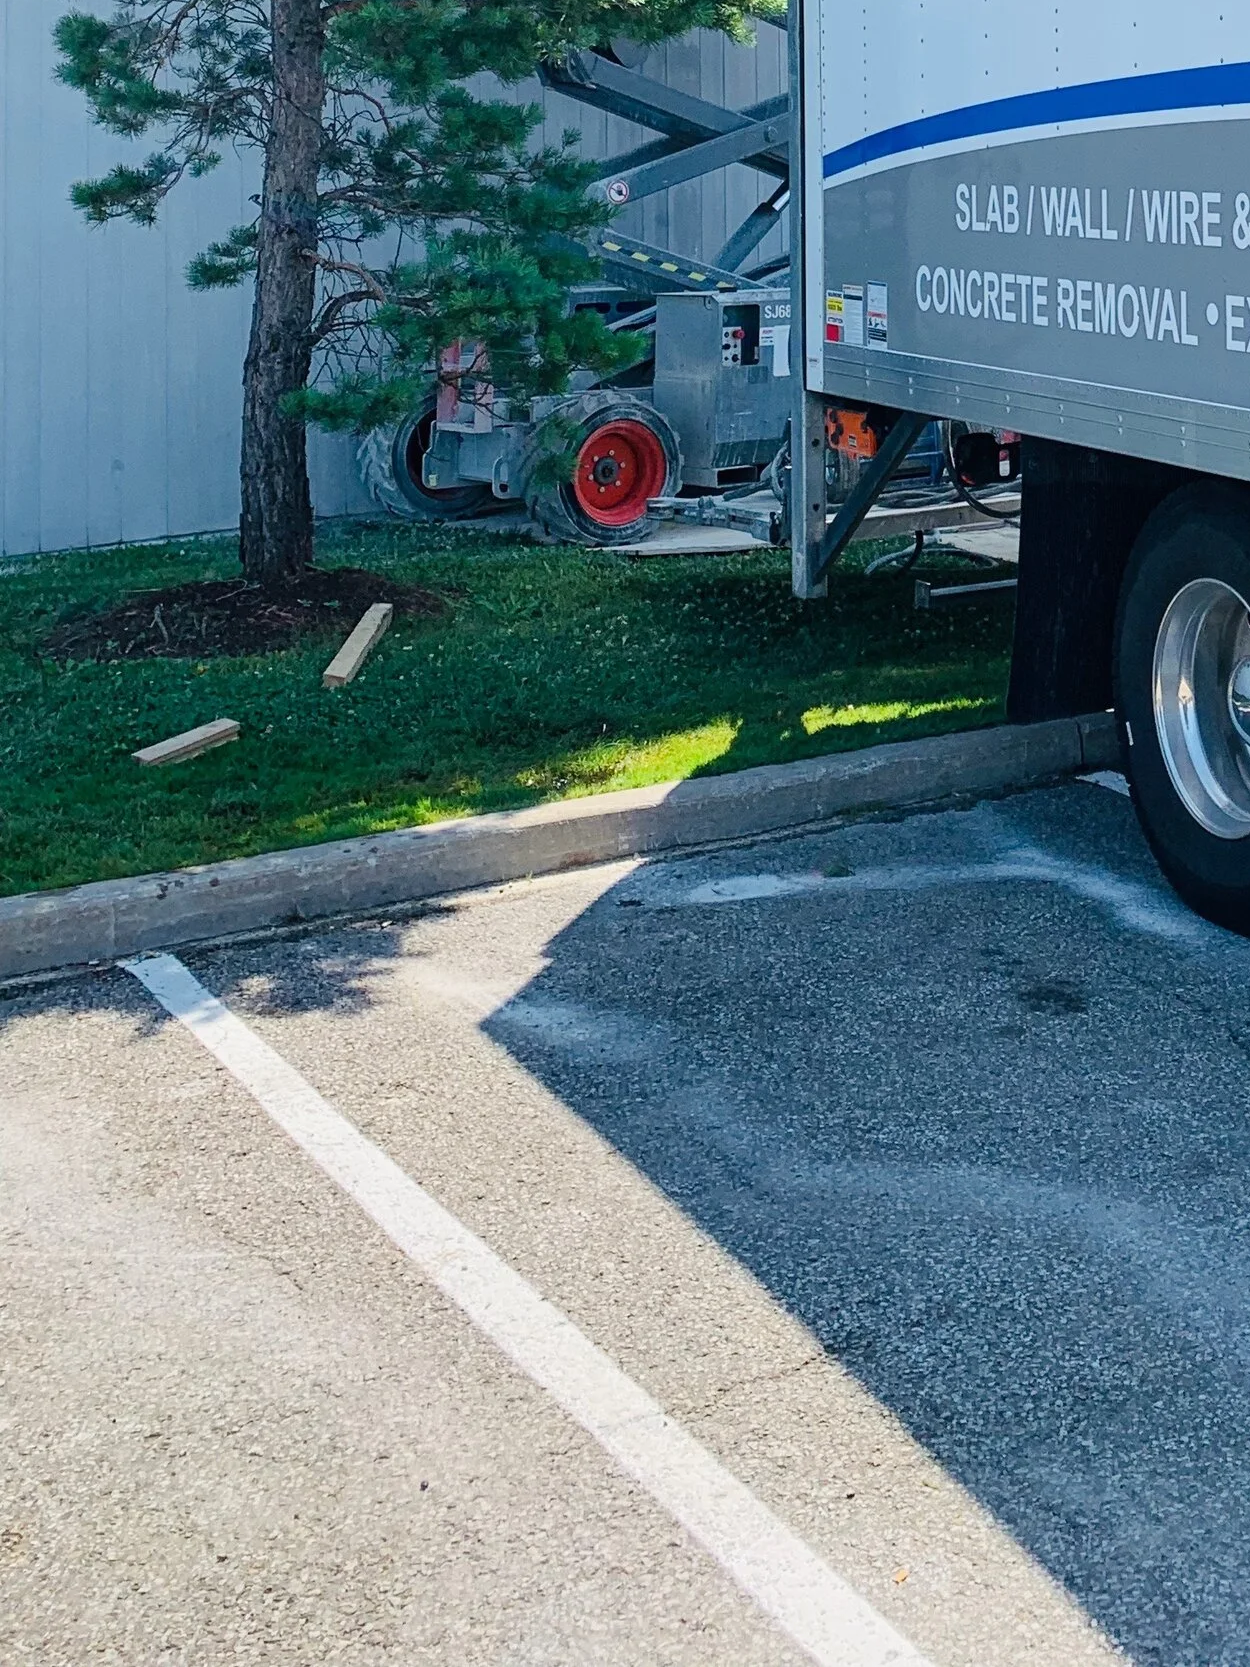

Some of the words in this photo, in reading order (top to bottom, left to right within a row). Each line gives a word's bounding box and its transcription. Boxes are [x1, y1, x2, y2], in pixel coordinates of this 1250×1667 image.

[954, 182, 1020, 234] SLAB
[1039, 185, 1119, 241] WALL
[1140, 188, 1222, 247] WIRE
[914, 263, 1049, 327] CONCRETE
[1056, 277, 1199, 346] REMOVAL
